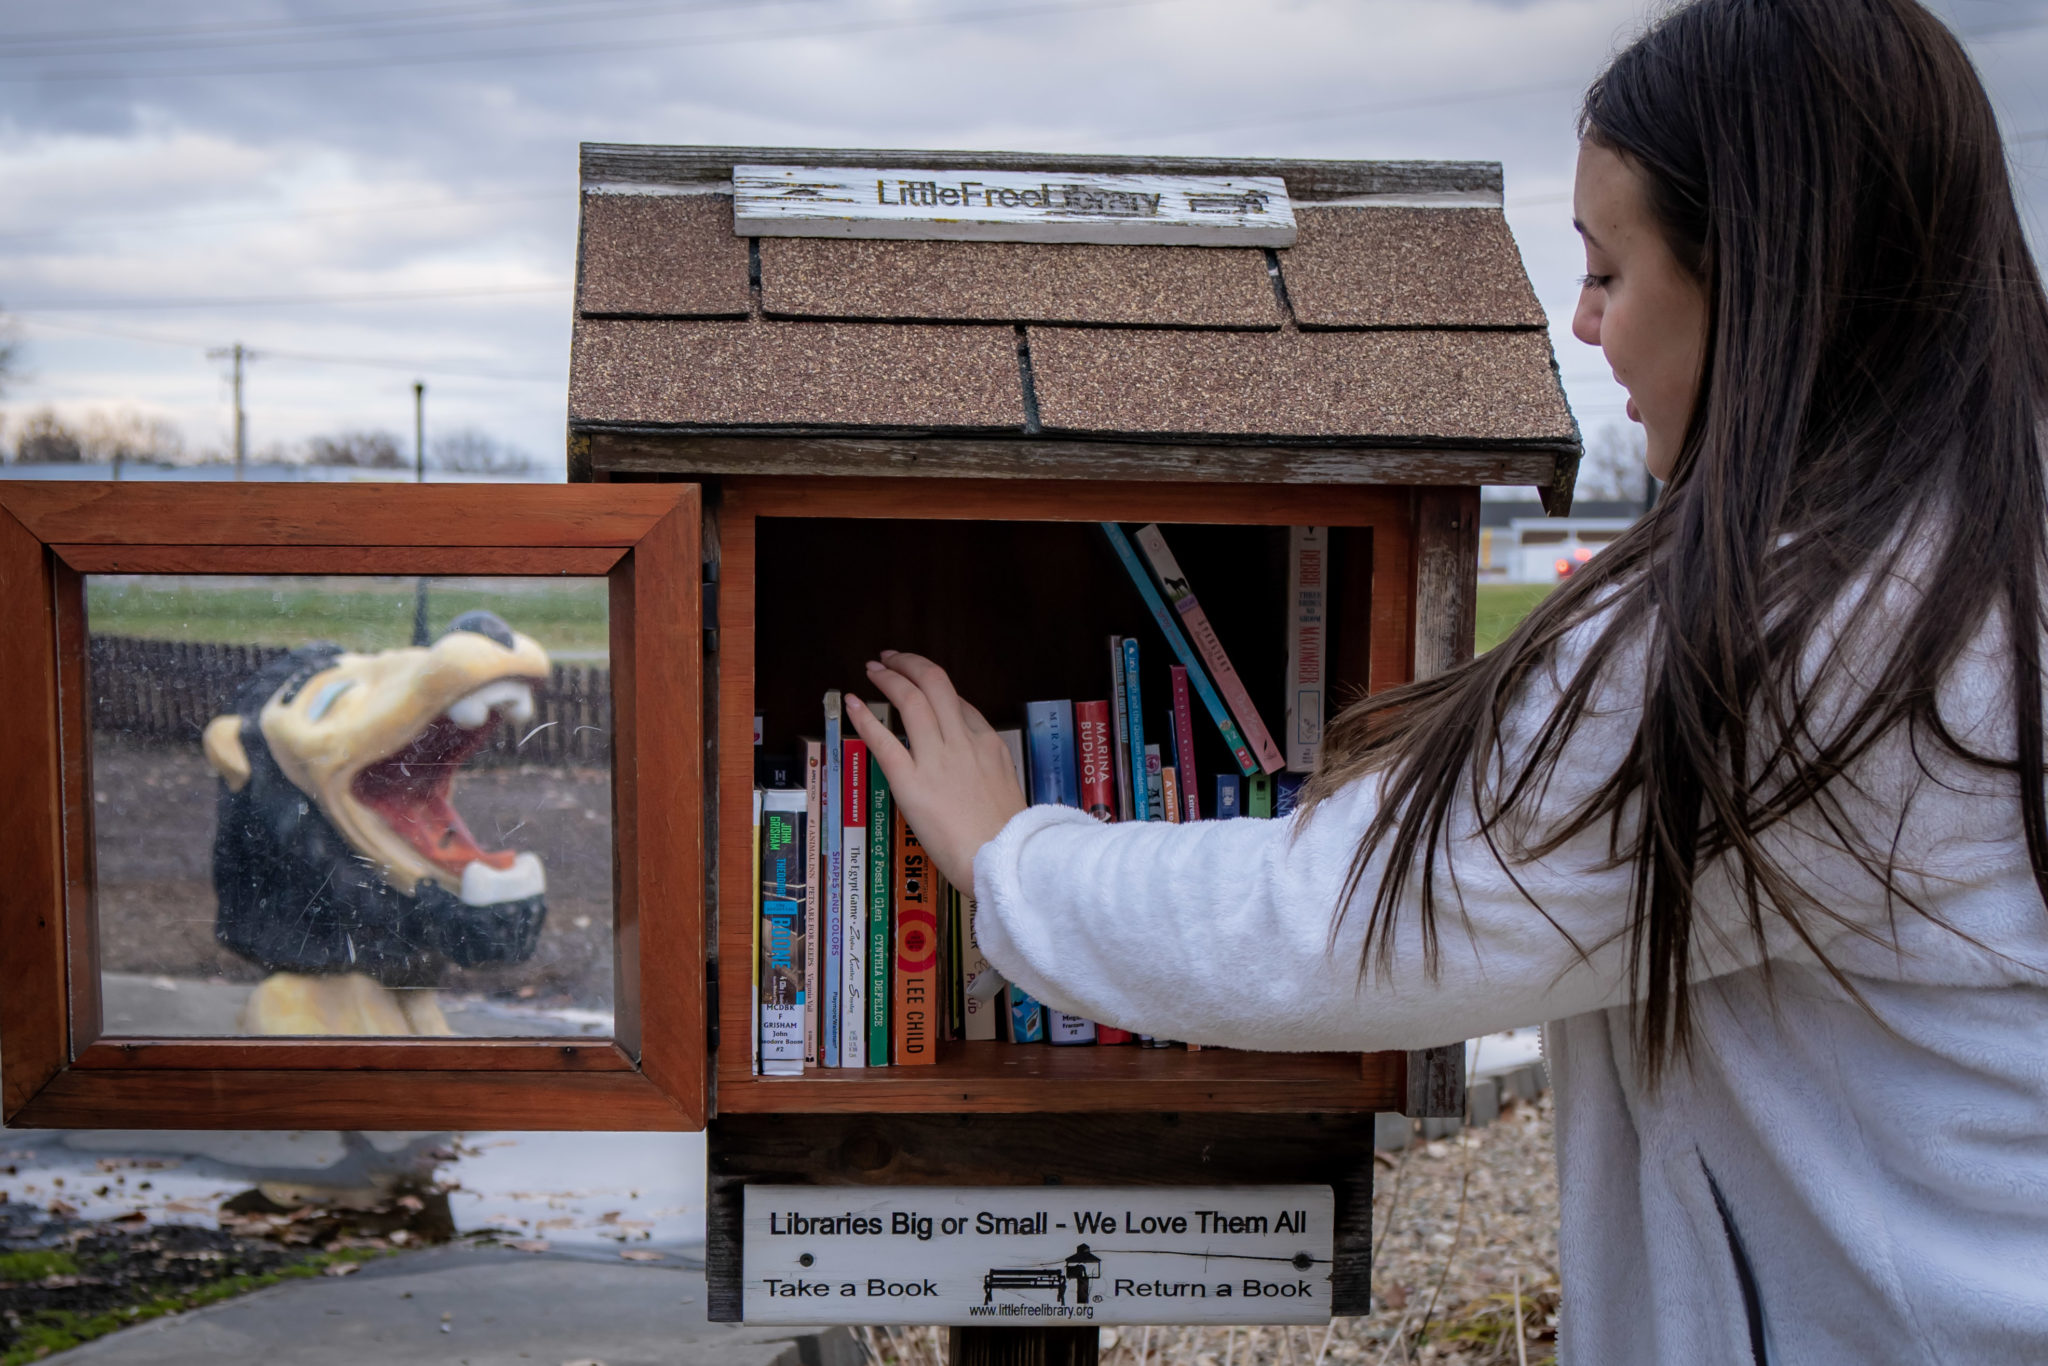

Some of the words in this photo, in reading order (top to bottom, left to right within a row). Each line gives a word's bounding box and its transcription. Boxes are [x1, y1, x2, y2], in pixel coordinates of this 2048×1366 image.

[1299, 549, 1321, 588] DEBBIE
[1298, 626, 1320, 684] MACOMBER
[1049, 711, 1062, 785] MIRANDA
[1080, 721, 1096, 784] BUDHOS
[1095, 721, 1110, 783] MARINA
[852, 752, 860, 787] YEARLING
[1165, 780, 1173, 788] A
[852, 789, 860, 823] NEWBERY
[874, 789, 885, 809] The
[1166, 789, 1174, 809] Visit
[1187, 794, 1196, 820] Extrem
[769, 815, 781, 850] GRISHAM
[781, 822, 792, 844] JOHN
[874, 811, 885, 842] Ghost
[808, 830, 816, 862] ANIMAL
[850, 846, 861, 864] The
[874, 845, 885, 858] of
[776, 858, 787, 897] THEODORE
[831, 851, 840, 889] SHAPES
[848, 865, 860, 892] Egypt
[874, 860, 885, 894] Fossil
[807, 886, 815, 907] PETS
[831, 892, 840, 914] AND
[850, 893, 859, 920] Game
[874, 897, 885, 922] Glen
[807, 907, 815, 923] ARE
[771, 917, 791, 969] BOONE
[807, 924, 815, 940] FOR
[831, 917, 840, 956] COLORS
[807, 941, 815, 967] KEEPS
[873, 934, 884, 977] CYNTHIA
[805, 973, 815, 999] Virginia
[907, 978, 924, 1004] LEE
[967, 973, 977, 1014] PUD
[766, 1003, 795, 1012] MCDBK
[873, 979, 884, 1028] DEFELICE
[772, 1030, 788, 1038] John
[906, 1011, 925, 1054] CHILD
[770, 1211, 882, 1236] Libraries
[891, 1211, 933, 1241] Big
[941, 1217, 968, 1235] or
[975, 1211, 1047, 1236] Small
[1074, 1210, 1117, 1235] We
[1125, 1210, 1188, 1235] Love
[1194, 1210, 1267, 1235] Them
[1274, 1210, 1306, 1234] All
[762, 1278, 830, 1297] Take
[839, 1283, 856, 1297] a
[867, 1278, 940, 1297] Book
[1114, 1279, 1206, 1298] Return
[1216, 1283, 1232, 1298] a
[1243, 1279, 1313, 1298] Book
[969, 1303, 1094, 1319] www.littlefreelibrary.org
